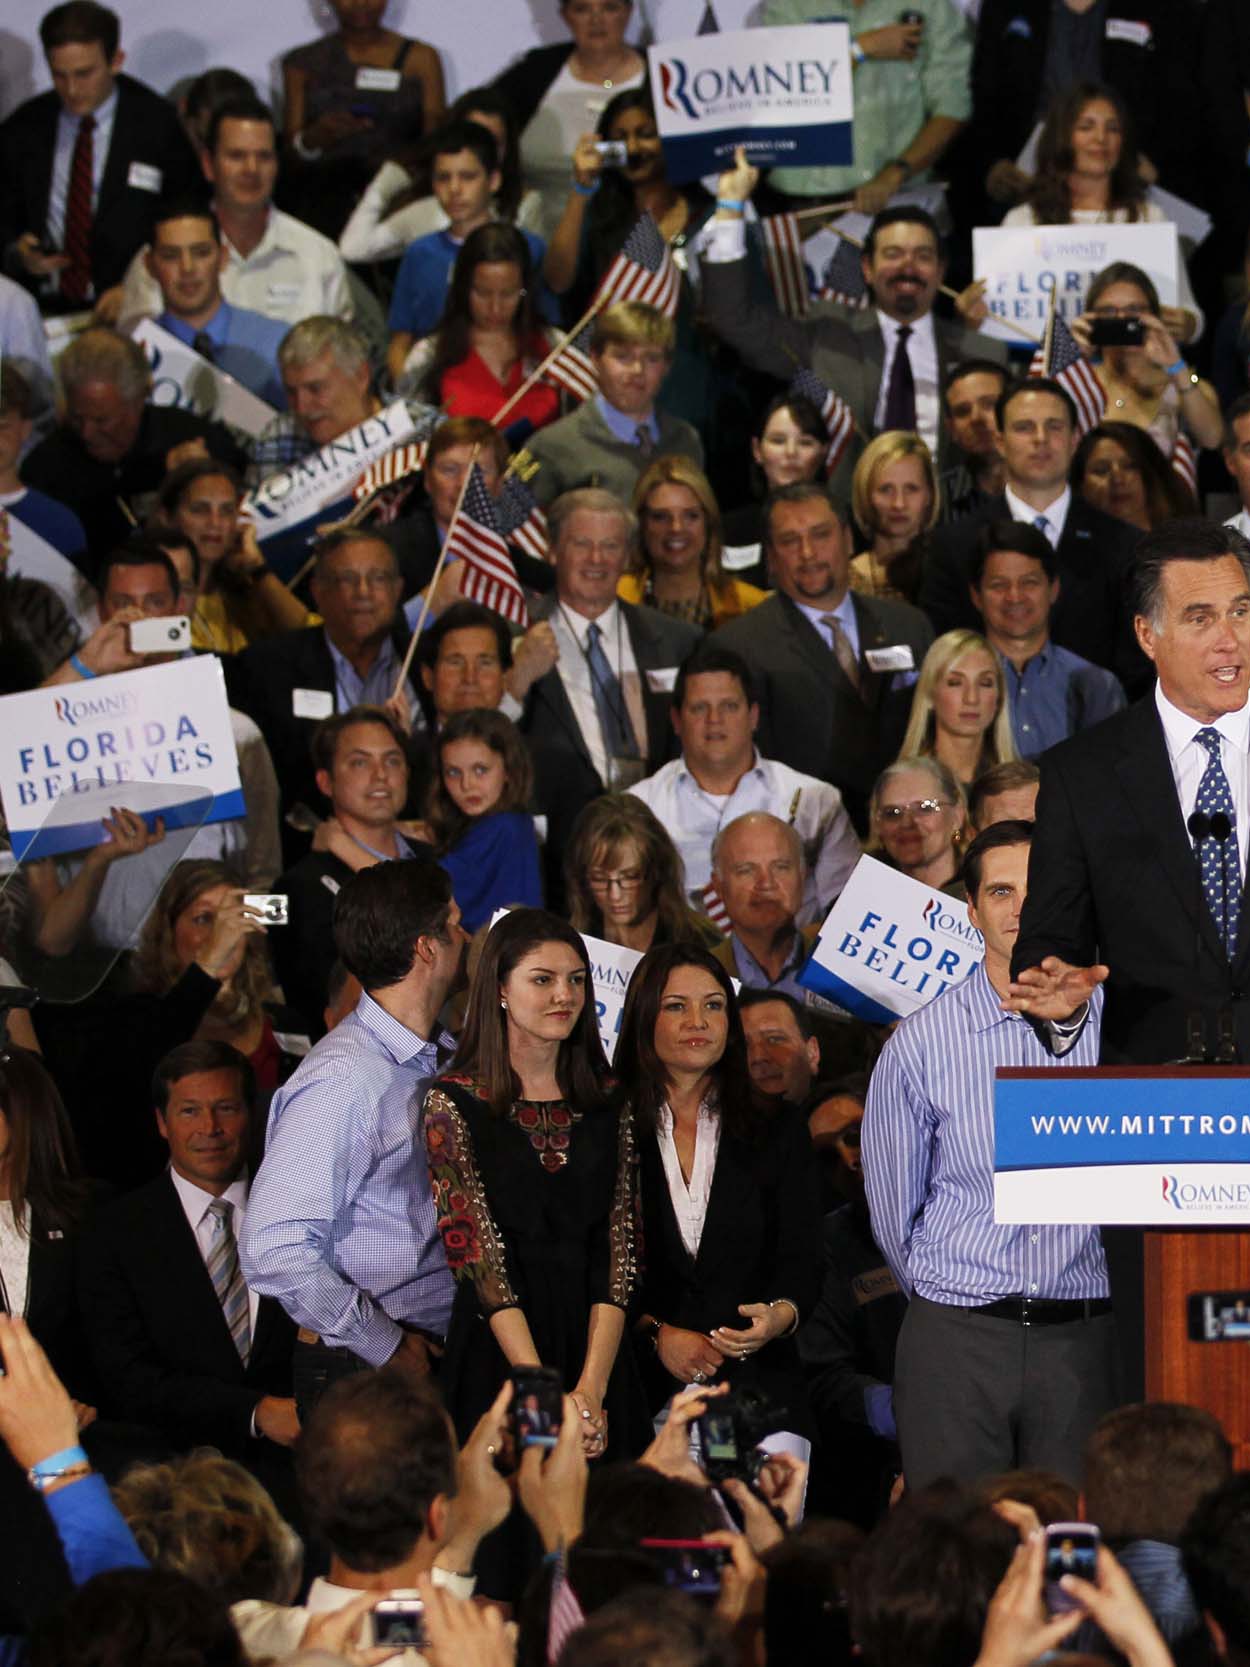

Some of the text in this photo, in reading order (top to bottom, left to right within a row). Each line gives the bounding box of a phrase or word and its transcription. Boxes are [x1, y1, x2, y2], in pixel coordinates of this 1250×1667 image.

[660, 59, 838, 118] ROMNEY
[54, 692, 140, 726] ROMNEY
[19, 715, 198, 774] FLORIDA
[17, 743, 213, 806] BELIEVES
